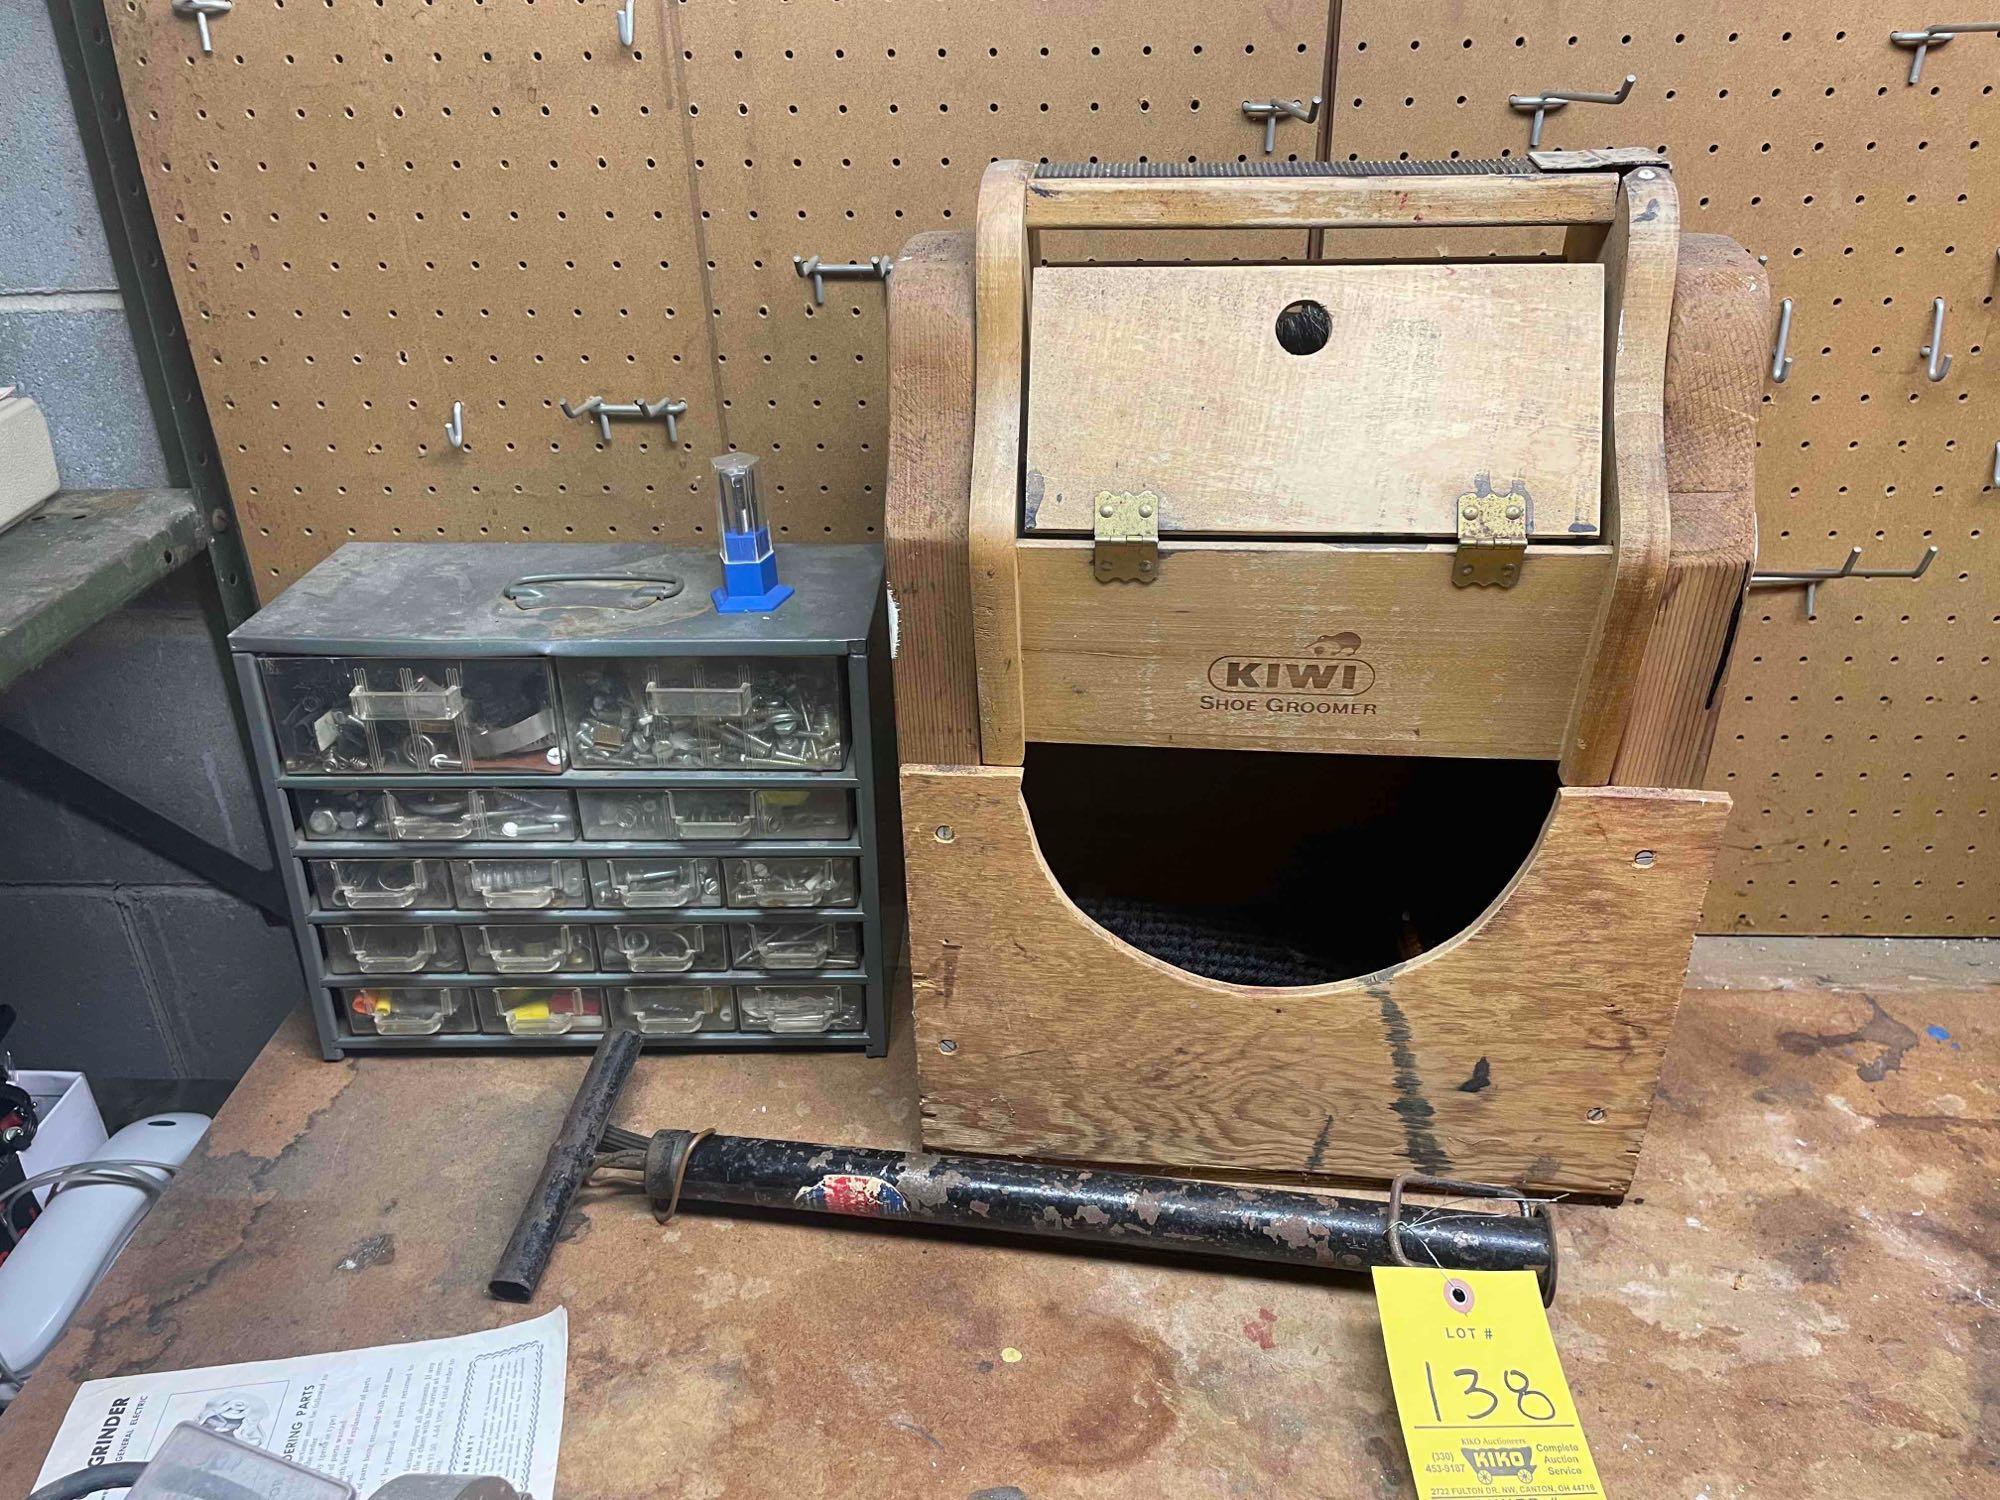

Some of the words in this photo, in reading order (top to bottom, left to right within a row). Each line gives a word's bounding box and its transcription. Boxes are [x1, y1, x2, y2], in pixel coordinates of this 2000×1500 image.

[1226, 662, 1357, 690] KIWI
[1445, 1327, 1476, 1339] LOT
[1484, 1328, 1493, 1339] #
[1425, 1361, 1556, 1422] 138
[296, 1385, 315, 1416] PARTS
[87, 1397, 130, 1466] GRINDER
[115, 1429, 134, 1461] GENERAL
[129, 1396, 148, 1425] ELECTRIC
[1461, 1438, 1481, 1446] KIKO
[1536, 1443, 1579, 1453] Complete
[1432, 1452, 1454, 1462] (330)
[1473, 1451, 1525, 1468] KIKO
[1544, 1454, 1579, 1464] Auction
[1547, 1466, 1582, 1476] Service
[1452, 1487, 1483, 1495] FULTON
[1558, 1485, 1570, 1493] OH
